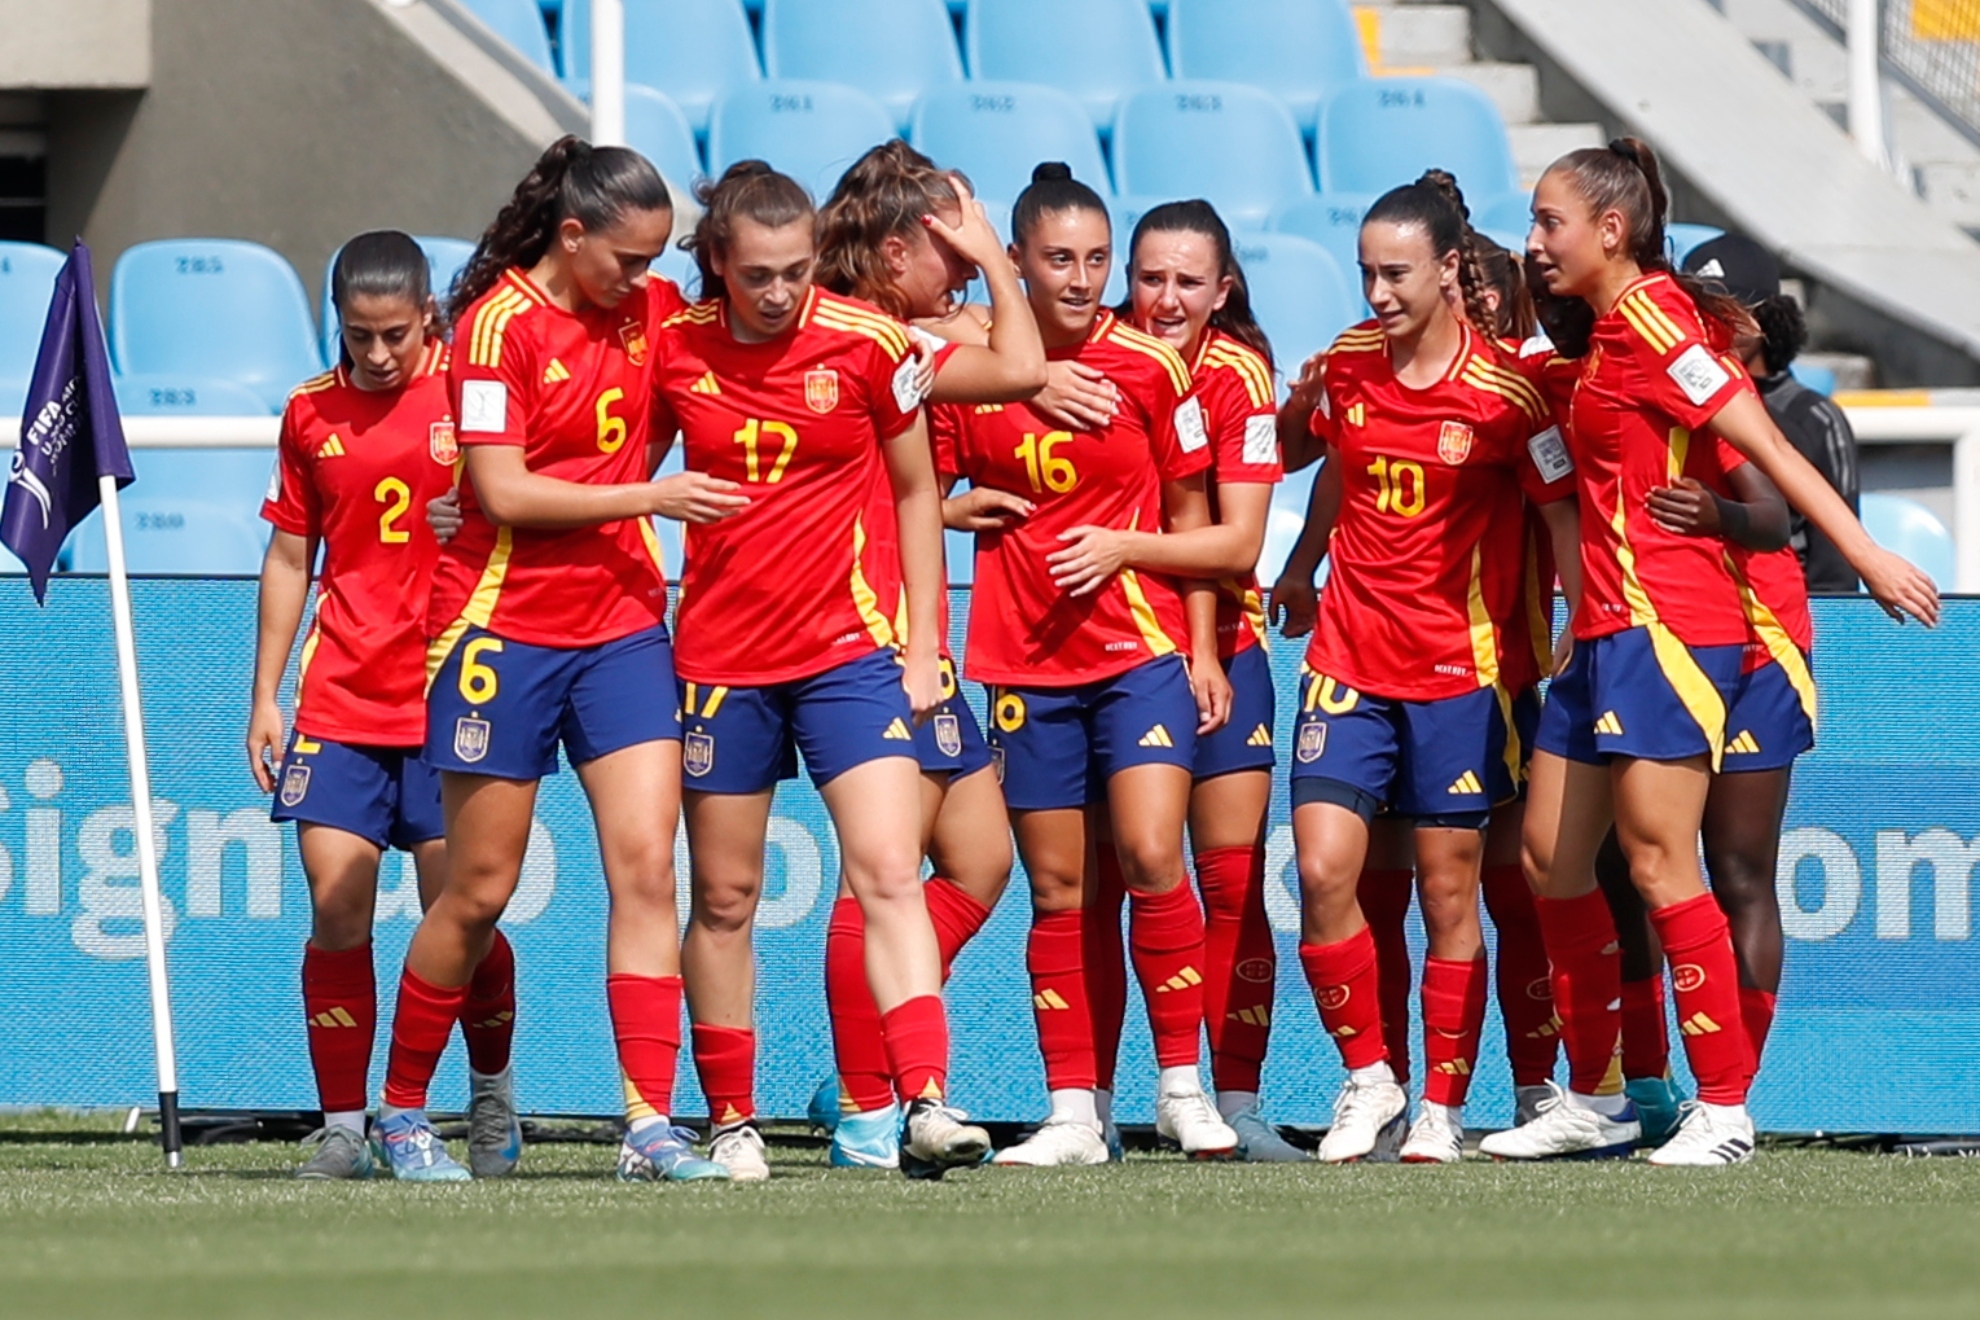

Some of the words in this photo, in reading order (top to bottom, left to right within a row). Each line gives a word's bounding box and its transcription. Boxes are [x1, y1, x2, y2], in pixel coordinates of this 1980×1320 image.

[26, 400, 62, 446] FIFA
[595, 386, 627, 455] 6
[733, 417, 799, 484] 17
[1013, 430, 1078, 494] 16
[1366, 454, 1426, 518] 10
[374, 476, 411, 543] 2
[458, 636, 504, 705] 6
[0, 757, 283, 961] ign
